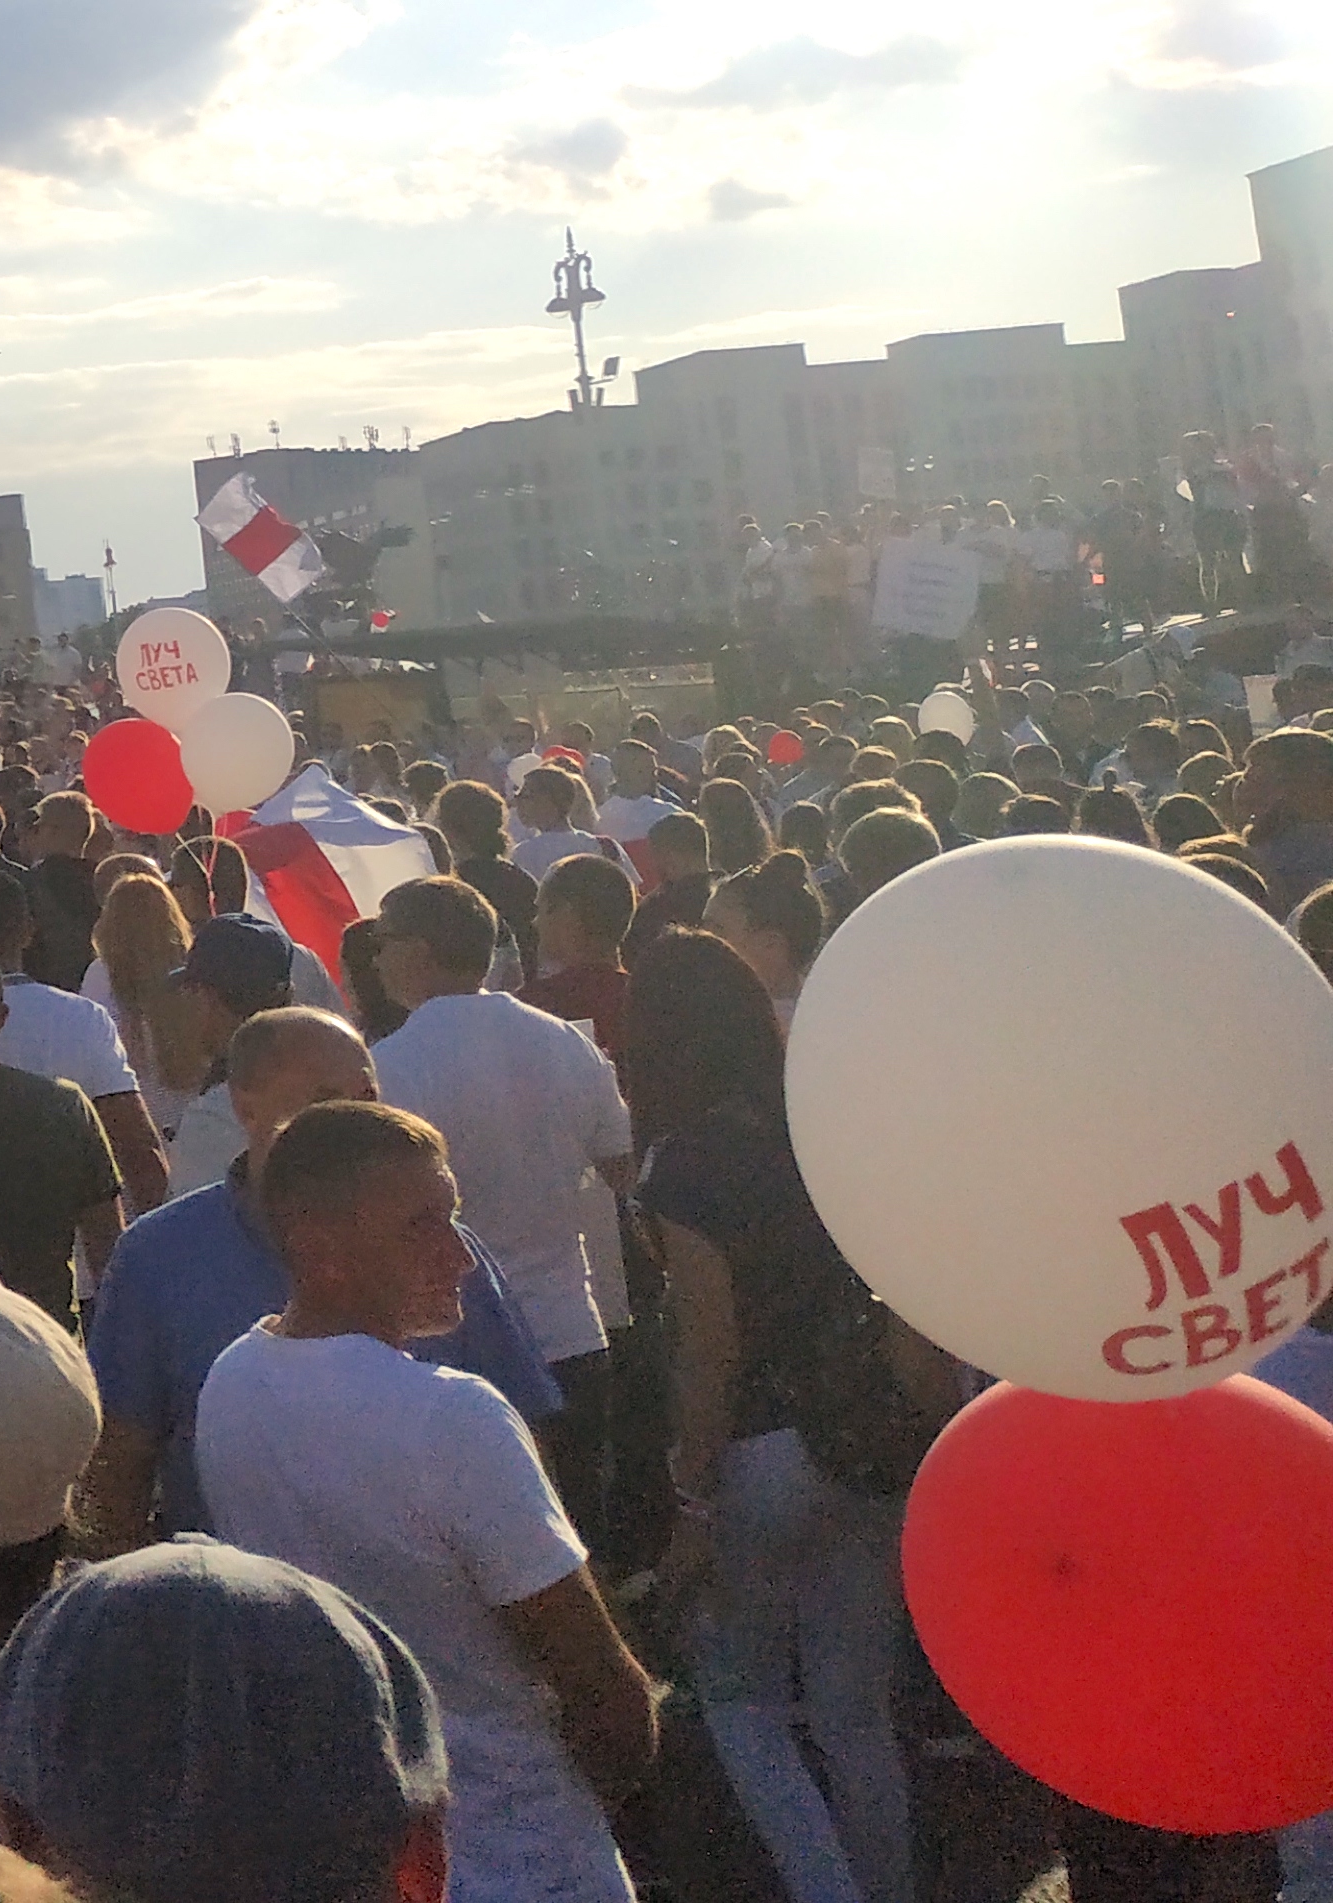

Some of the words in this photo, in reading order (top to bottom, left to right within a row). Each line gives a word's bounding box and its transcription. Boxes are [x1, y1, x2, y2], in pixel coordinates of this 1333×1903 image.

[140, 640, 181, 668] ЛУЧ
[136, 663, 199, 691] СВЕТА
[1119, 1140, 1324, 1312] ЛУЧ
